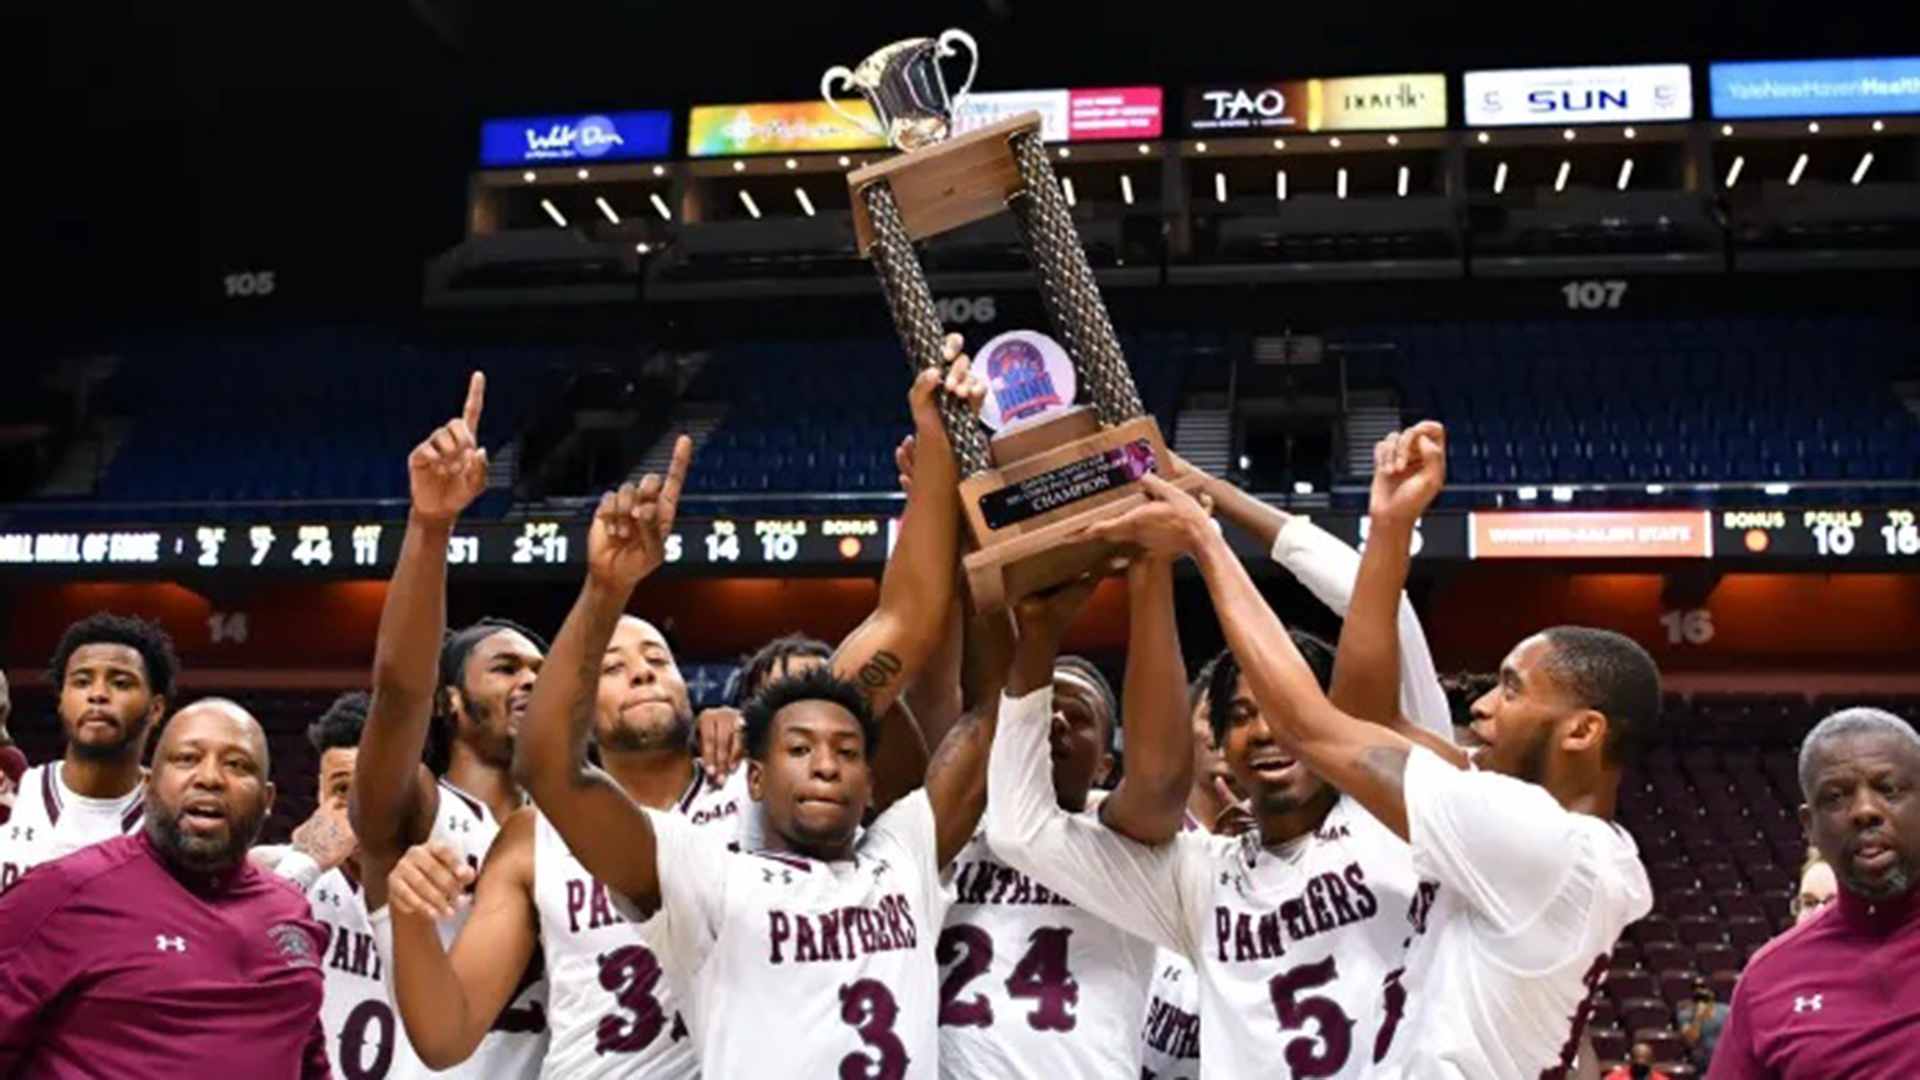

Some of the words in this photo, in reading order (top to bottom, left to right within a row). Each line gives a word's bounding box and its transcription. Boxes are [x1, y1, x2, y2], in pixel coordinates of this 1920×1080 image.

[1203, 89, 1285, 118] TAO
[1526, 89, 1629, 113] SUN
[224, 271, 275, 297] 105
[1562, 281, 1627, 308] 107
[936, 297, 996, 322] 106
[1032, 474, 1110, 511] CHAMPION
[822, 520, 877, 535] BONUS
[1723, 511, 1785, 529] BONUS
[1803, 511, 1863, 528] FOULS
[1887, 511, 1914, 527] TO
[292, 540, 333, 566] 44
[512, 537, 567, 562] 2-11
[706, 534, 739, 561] 14
[761, 535, 798, 561] 10
[1812, 525, 1855, 555] 10
[207, 613, 248, 643] 14
[1660, 609, 1714, 643] 16
[768, 894, 918, 964] PANTHERS
[935, 923, 1079, 1032] 24
[838, 977, 911, 1080] 3
[1269, 955, 1358, 1080] 5
[337, 998, 396, 1080] 0
